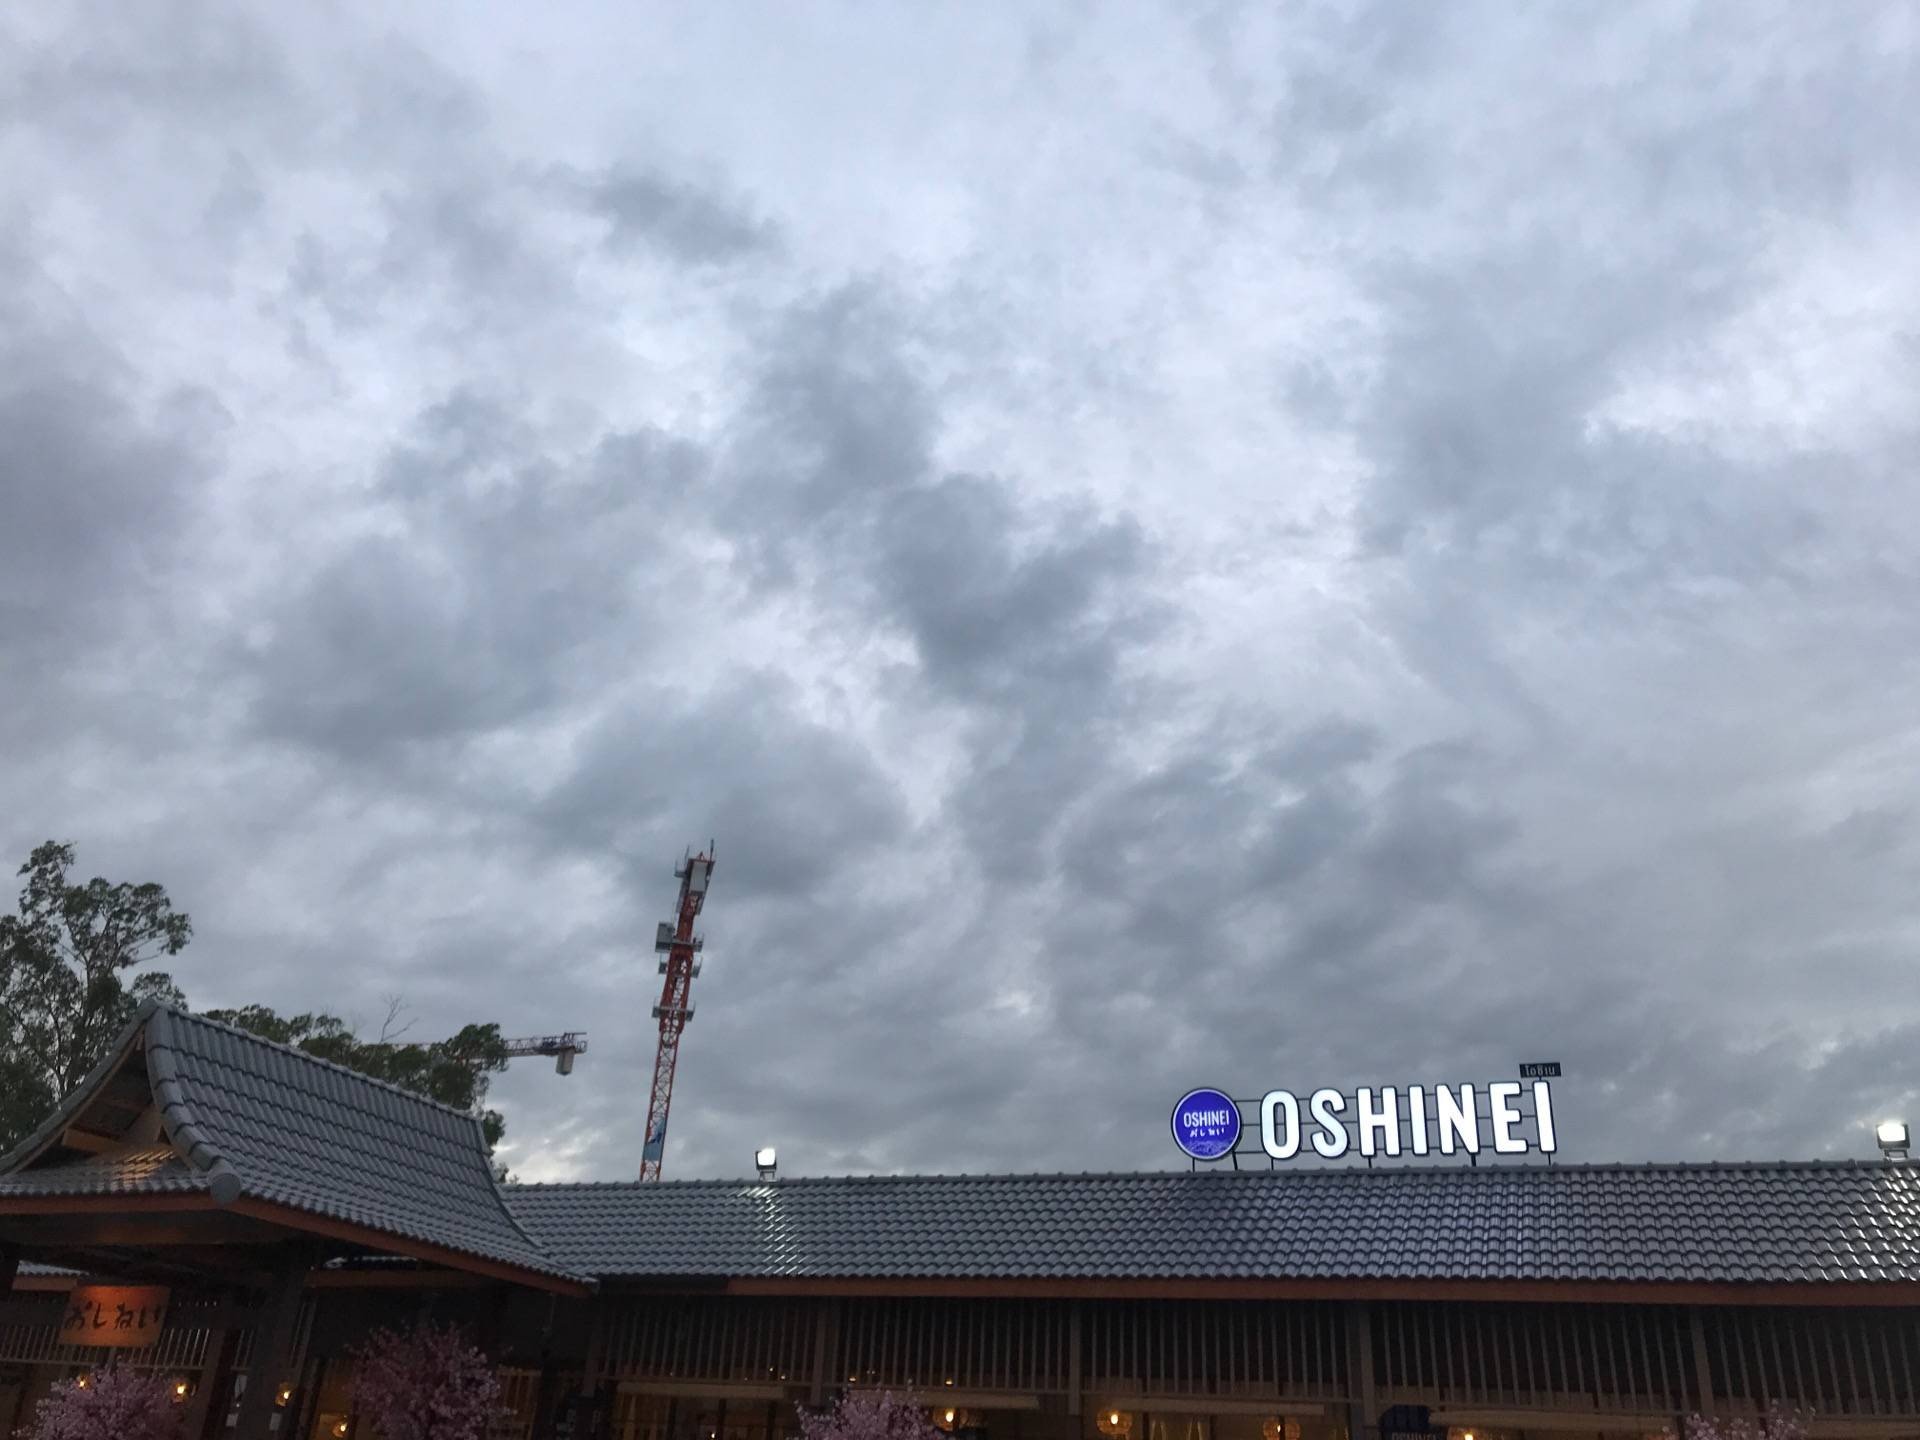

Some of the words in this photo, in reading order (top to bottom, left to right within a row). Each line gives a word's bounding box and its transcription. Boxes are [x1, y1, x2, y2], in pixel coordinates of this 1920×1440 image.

[1184, 1110, 1229, 1128] OSHINEI
[1261, 1081, 1556, 1160] OSHINEI
[65, 1300, 161, 1330] おしねい
